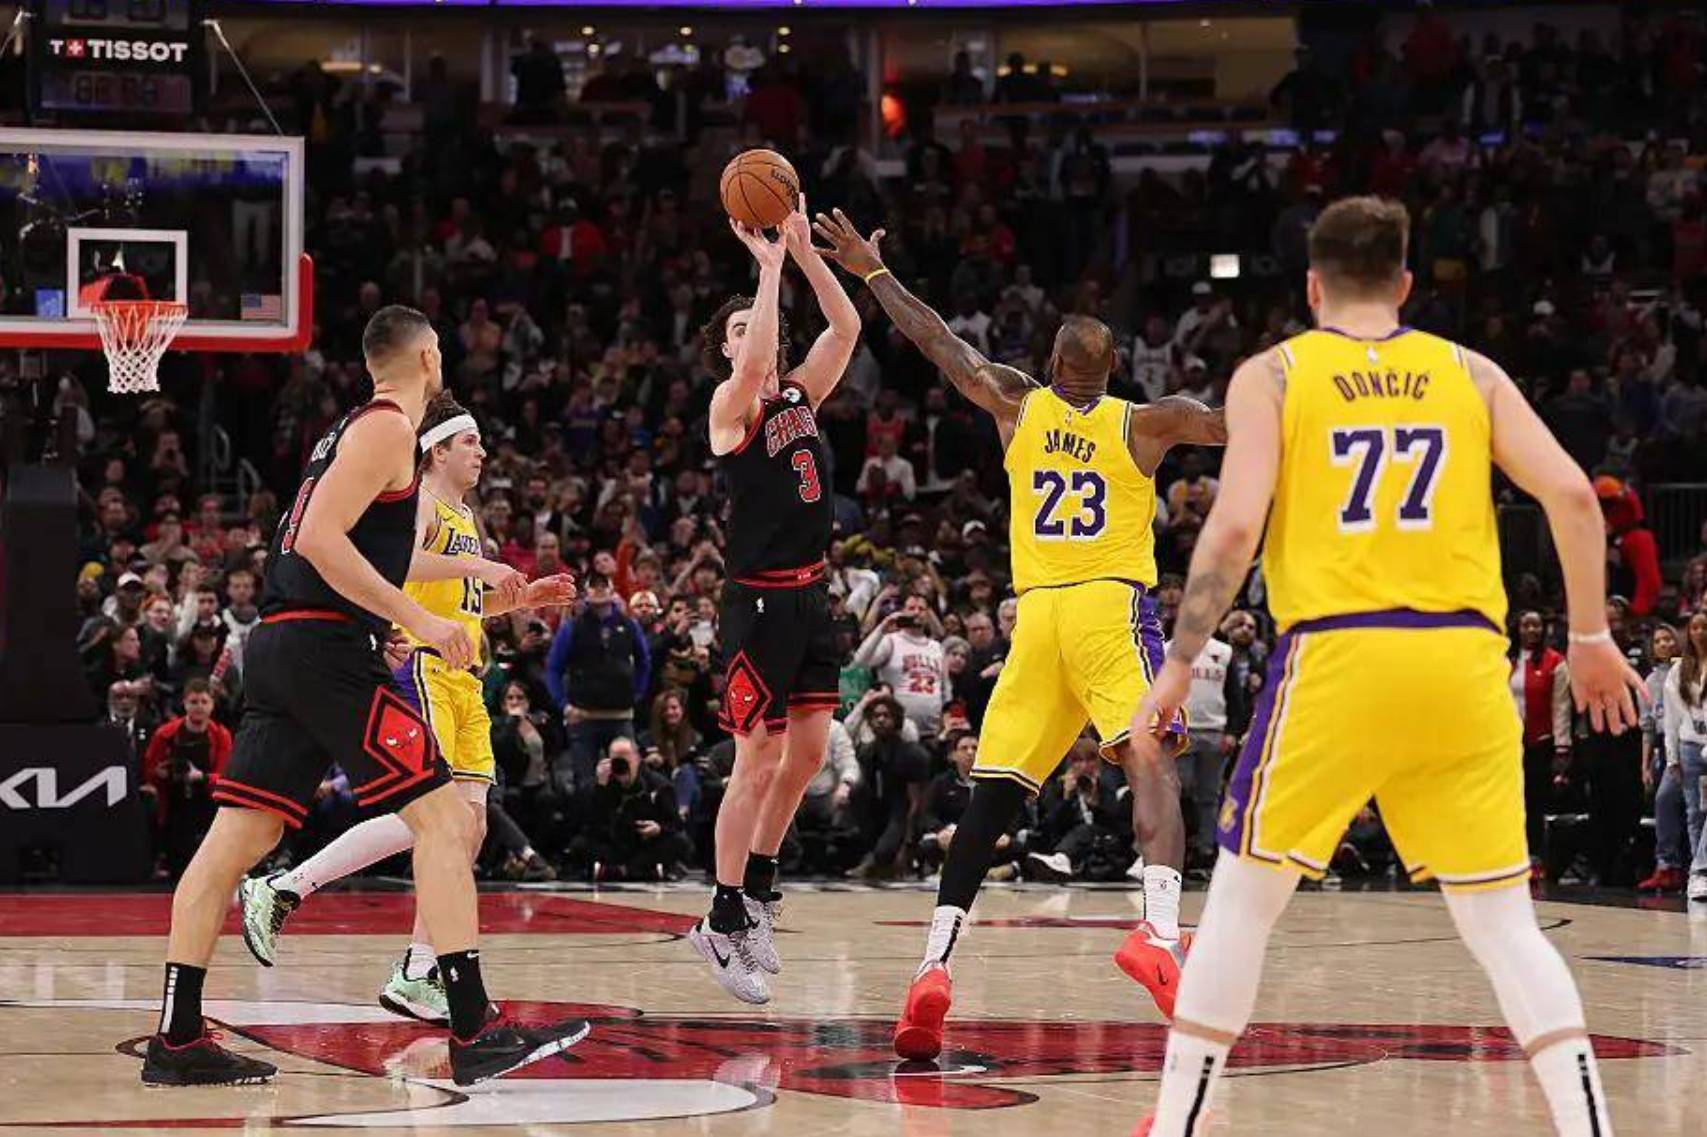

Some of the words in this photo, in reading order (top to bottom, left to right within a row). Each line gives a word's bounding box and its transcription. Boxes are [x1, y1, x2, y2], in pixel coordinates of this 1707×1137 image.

[87, 39, 188, 62] TISSOT
[1333, 369, 1430, 402] DONČIĆ
[1044, 428, 1096, 463] JAMES
[791, 448, 821, 502] 3
[1330, 425, 1448, 532] 77
[1032, 469, 1107, 537] 23
